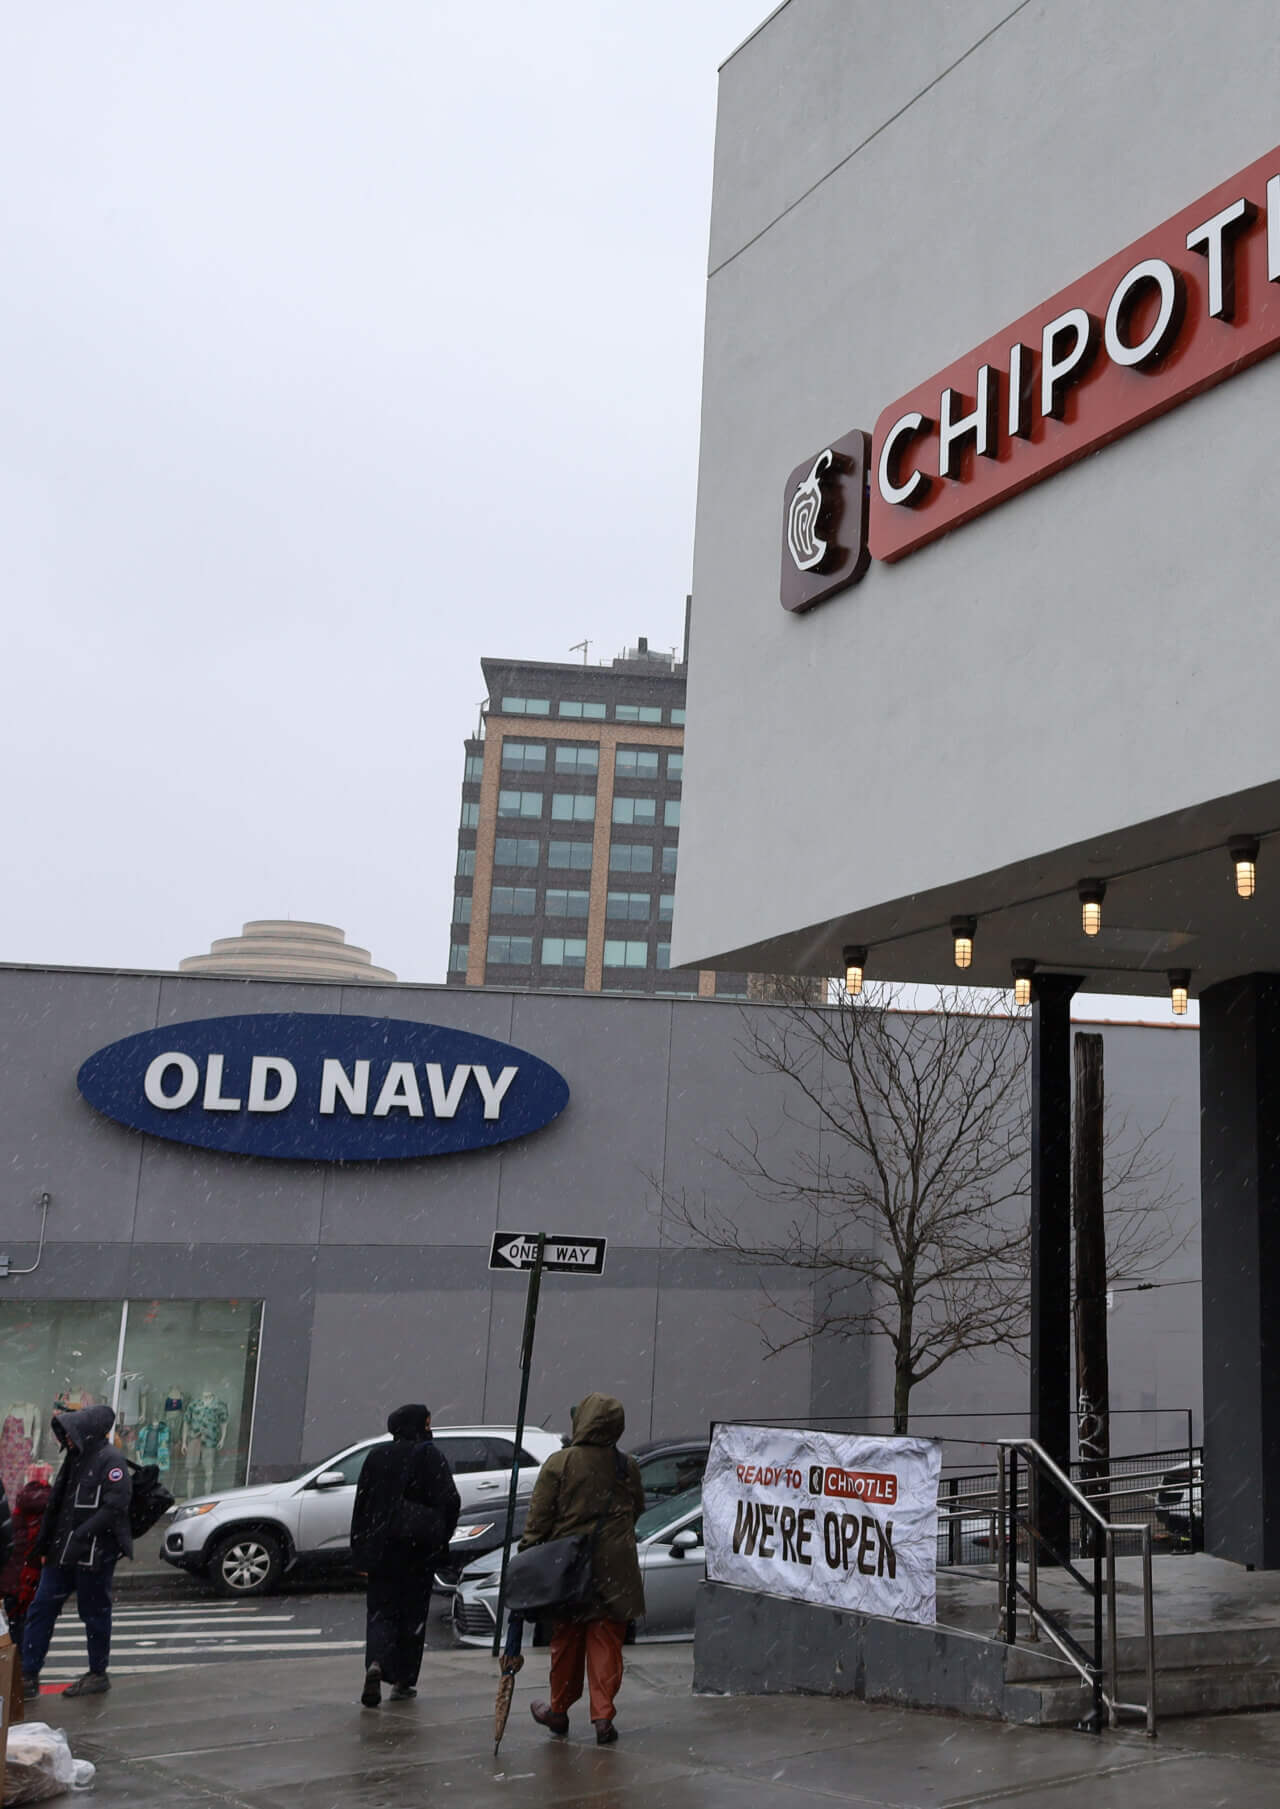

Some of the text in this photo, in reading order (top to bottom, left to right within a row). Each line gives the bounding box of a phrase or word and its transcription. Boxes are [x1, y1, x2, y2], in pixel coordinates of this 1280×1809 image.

[144, 1051, 519, 1120] OLD NAVY
[509, 1244, 590, 1263] ONE WAY
[736, 1464, 781, 1487] READY
[784, 1468, 803, 1489] TO
[732, 1500, 897, 1580] WE'RE OPEN
